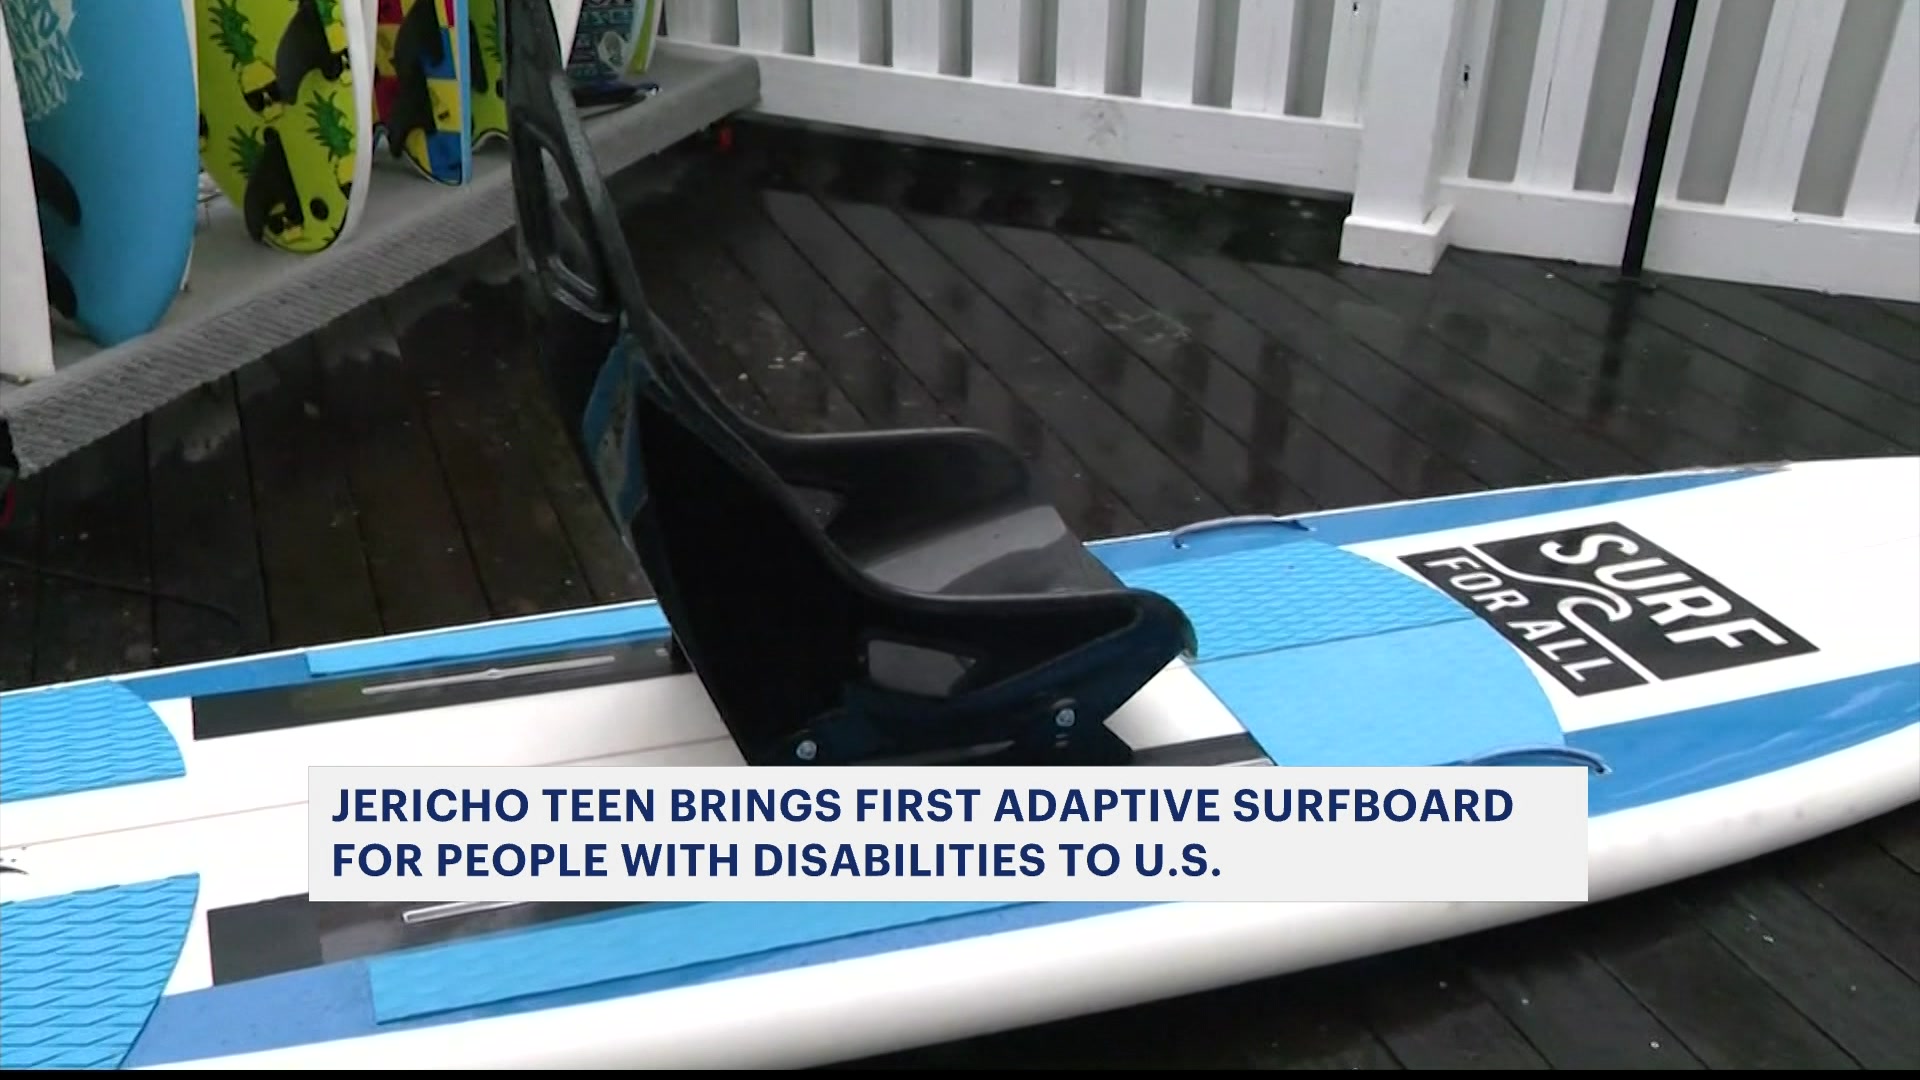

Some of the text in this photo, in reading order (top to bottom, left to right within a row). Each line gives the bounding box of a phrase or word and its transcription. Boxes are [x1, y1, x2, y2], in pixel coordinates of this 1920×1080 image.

[1425, 555, 1615, 682] FOR ALL
[1538, 533, 1789, 649] SURF
